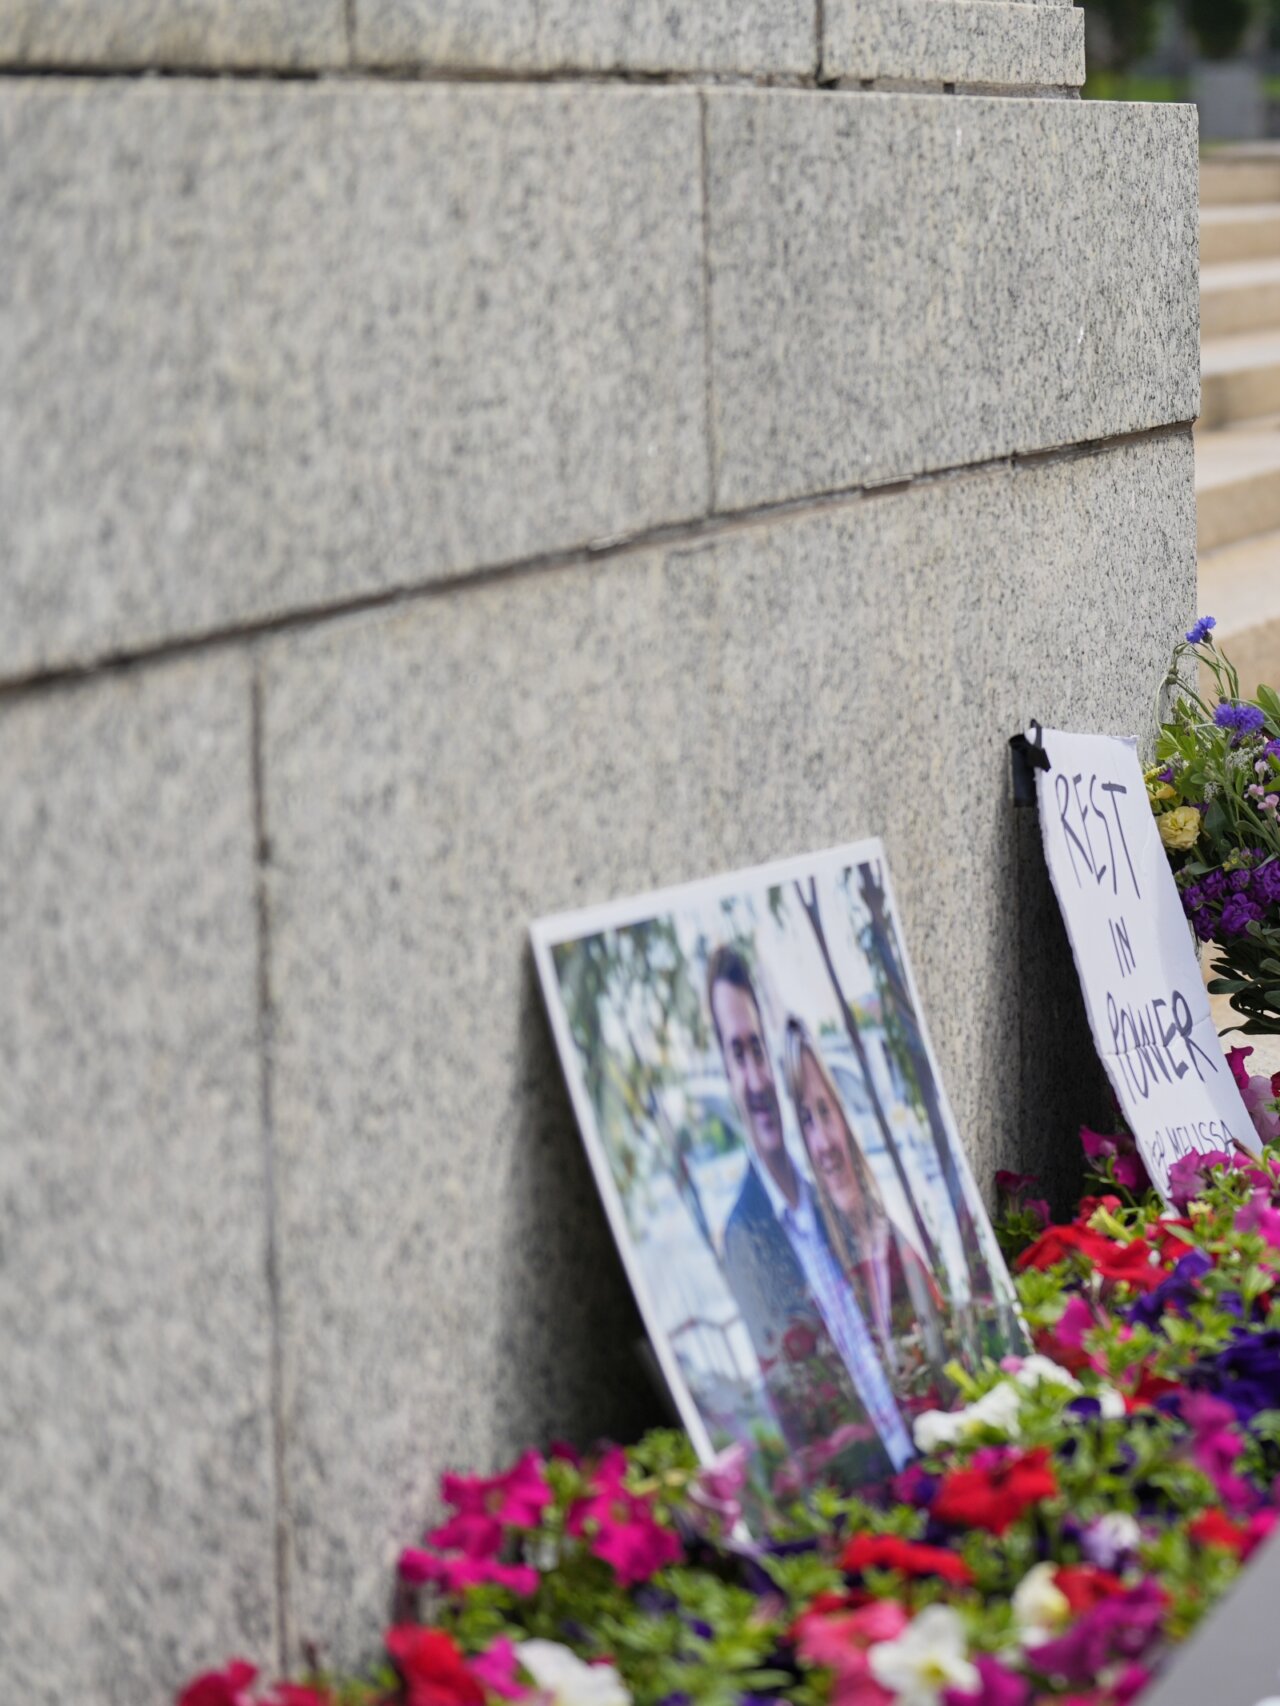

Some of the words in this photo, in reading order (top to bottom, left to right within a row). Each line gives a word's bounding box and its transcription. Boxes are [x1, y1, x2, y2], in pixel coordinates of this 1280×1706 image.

[1055, 773, 1141, 899] REST
[1108, 916, 1136, 979] IN
[1107, 990, 1218, 1104] POWER
